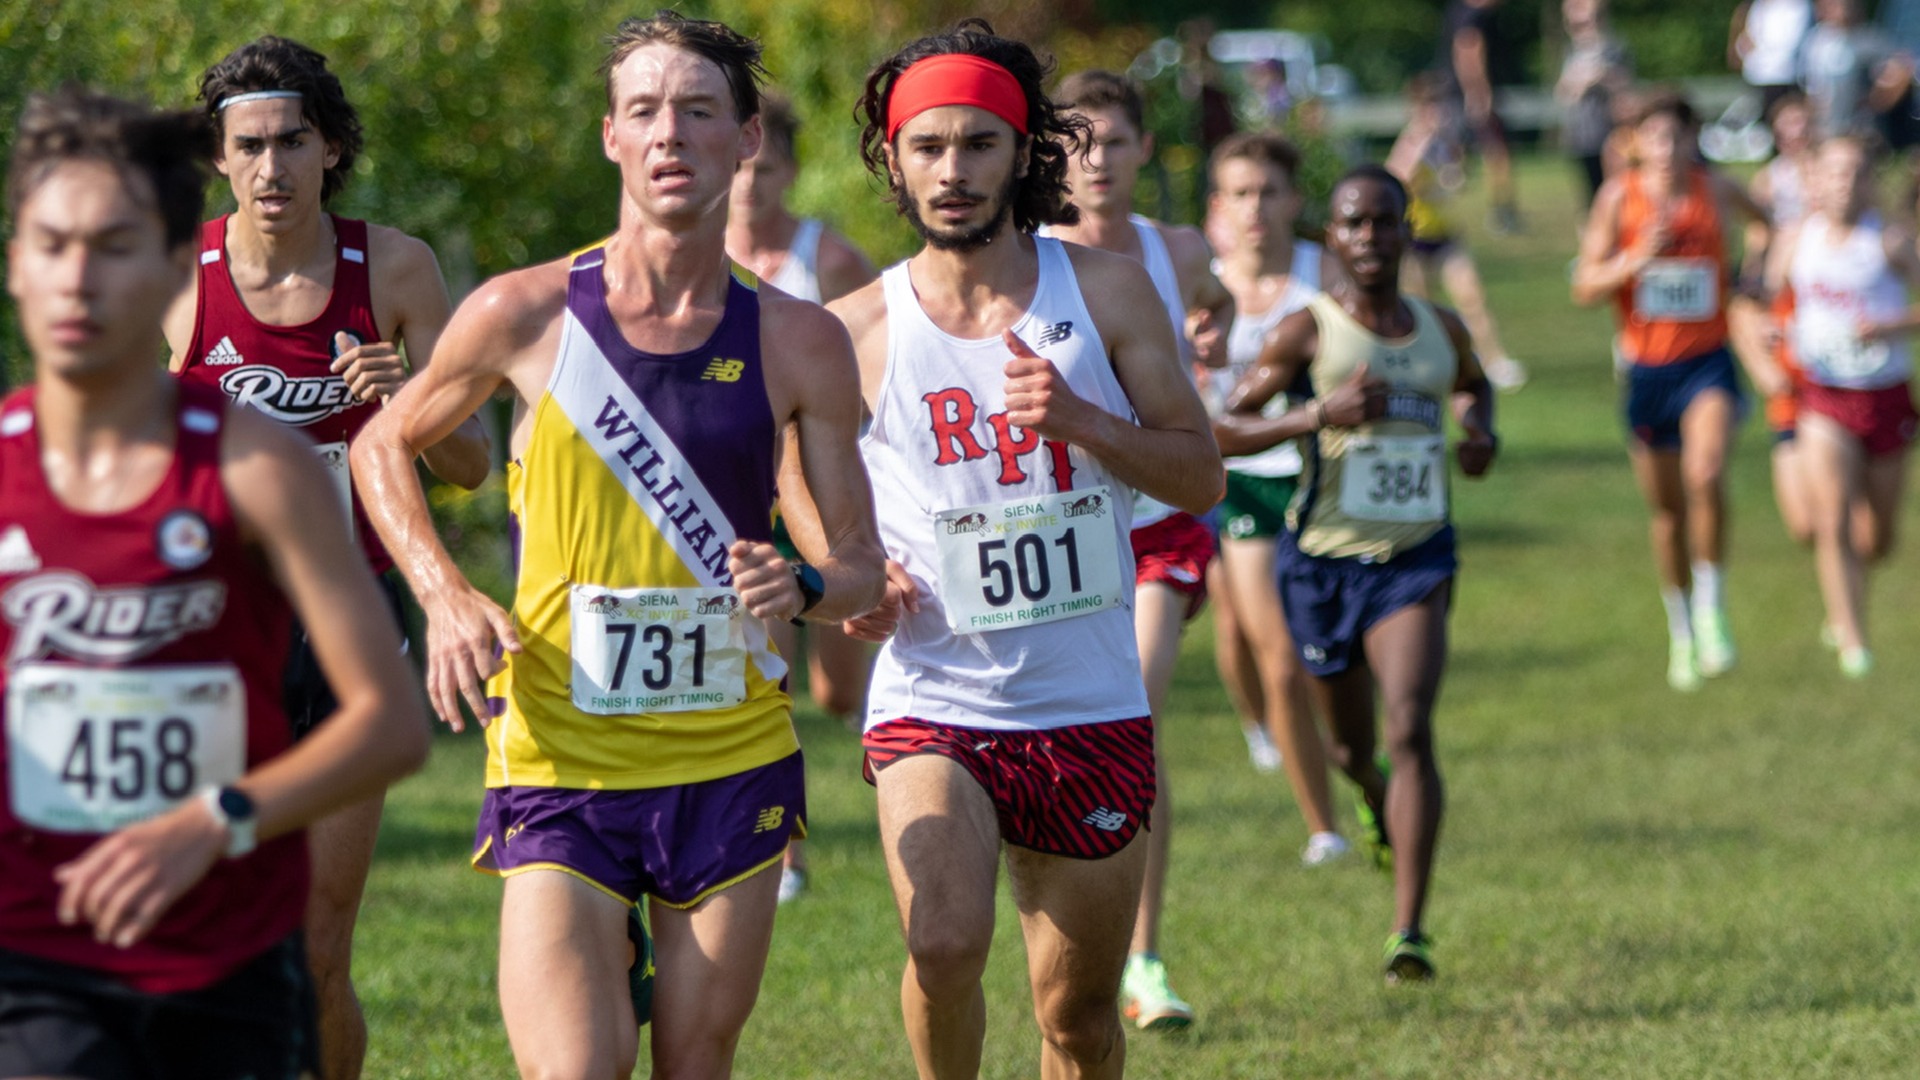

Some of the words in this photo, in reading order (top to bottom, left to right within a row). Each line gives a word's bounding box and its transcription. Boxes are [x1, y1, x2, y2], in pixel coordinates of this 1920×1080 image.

[205, 354, 244, 366] adidas
[219, 364, 366, 427] RIDE
[594, 394, 733, 588] WILLIAM
[1369, 462, 1431, 504] 384
[994, 522, 1013, 533] XC
[1016, 515, 1059, 530] INVITE
[1004, 503, 1045, 518] SIENA
[978, 527, 1082, 607] 501
[3, 570, 226, 664] RIDER
[626, 609, 645, 620] XC
[648, 609, 691, 620] INVITE
[638, 594, 679, 607] SIENA
[970, 611, 1014, 627] FINISH
[1017, 604, 1057, 620] RIGHT
[1060, 594, 1103, 613] TIMING
[605, 623, 706, 691] 731
[591, 697, 632, 708] FINISH
[635, 695, 677, 707] RIGHT
[679, 692, 725, 704] TIMING
[61, 718, 195, 800] 458
